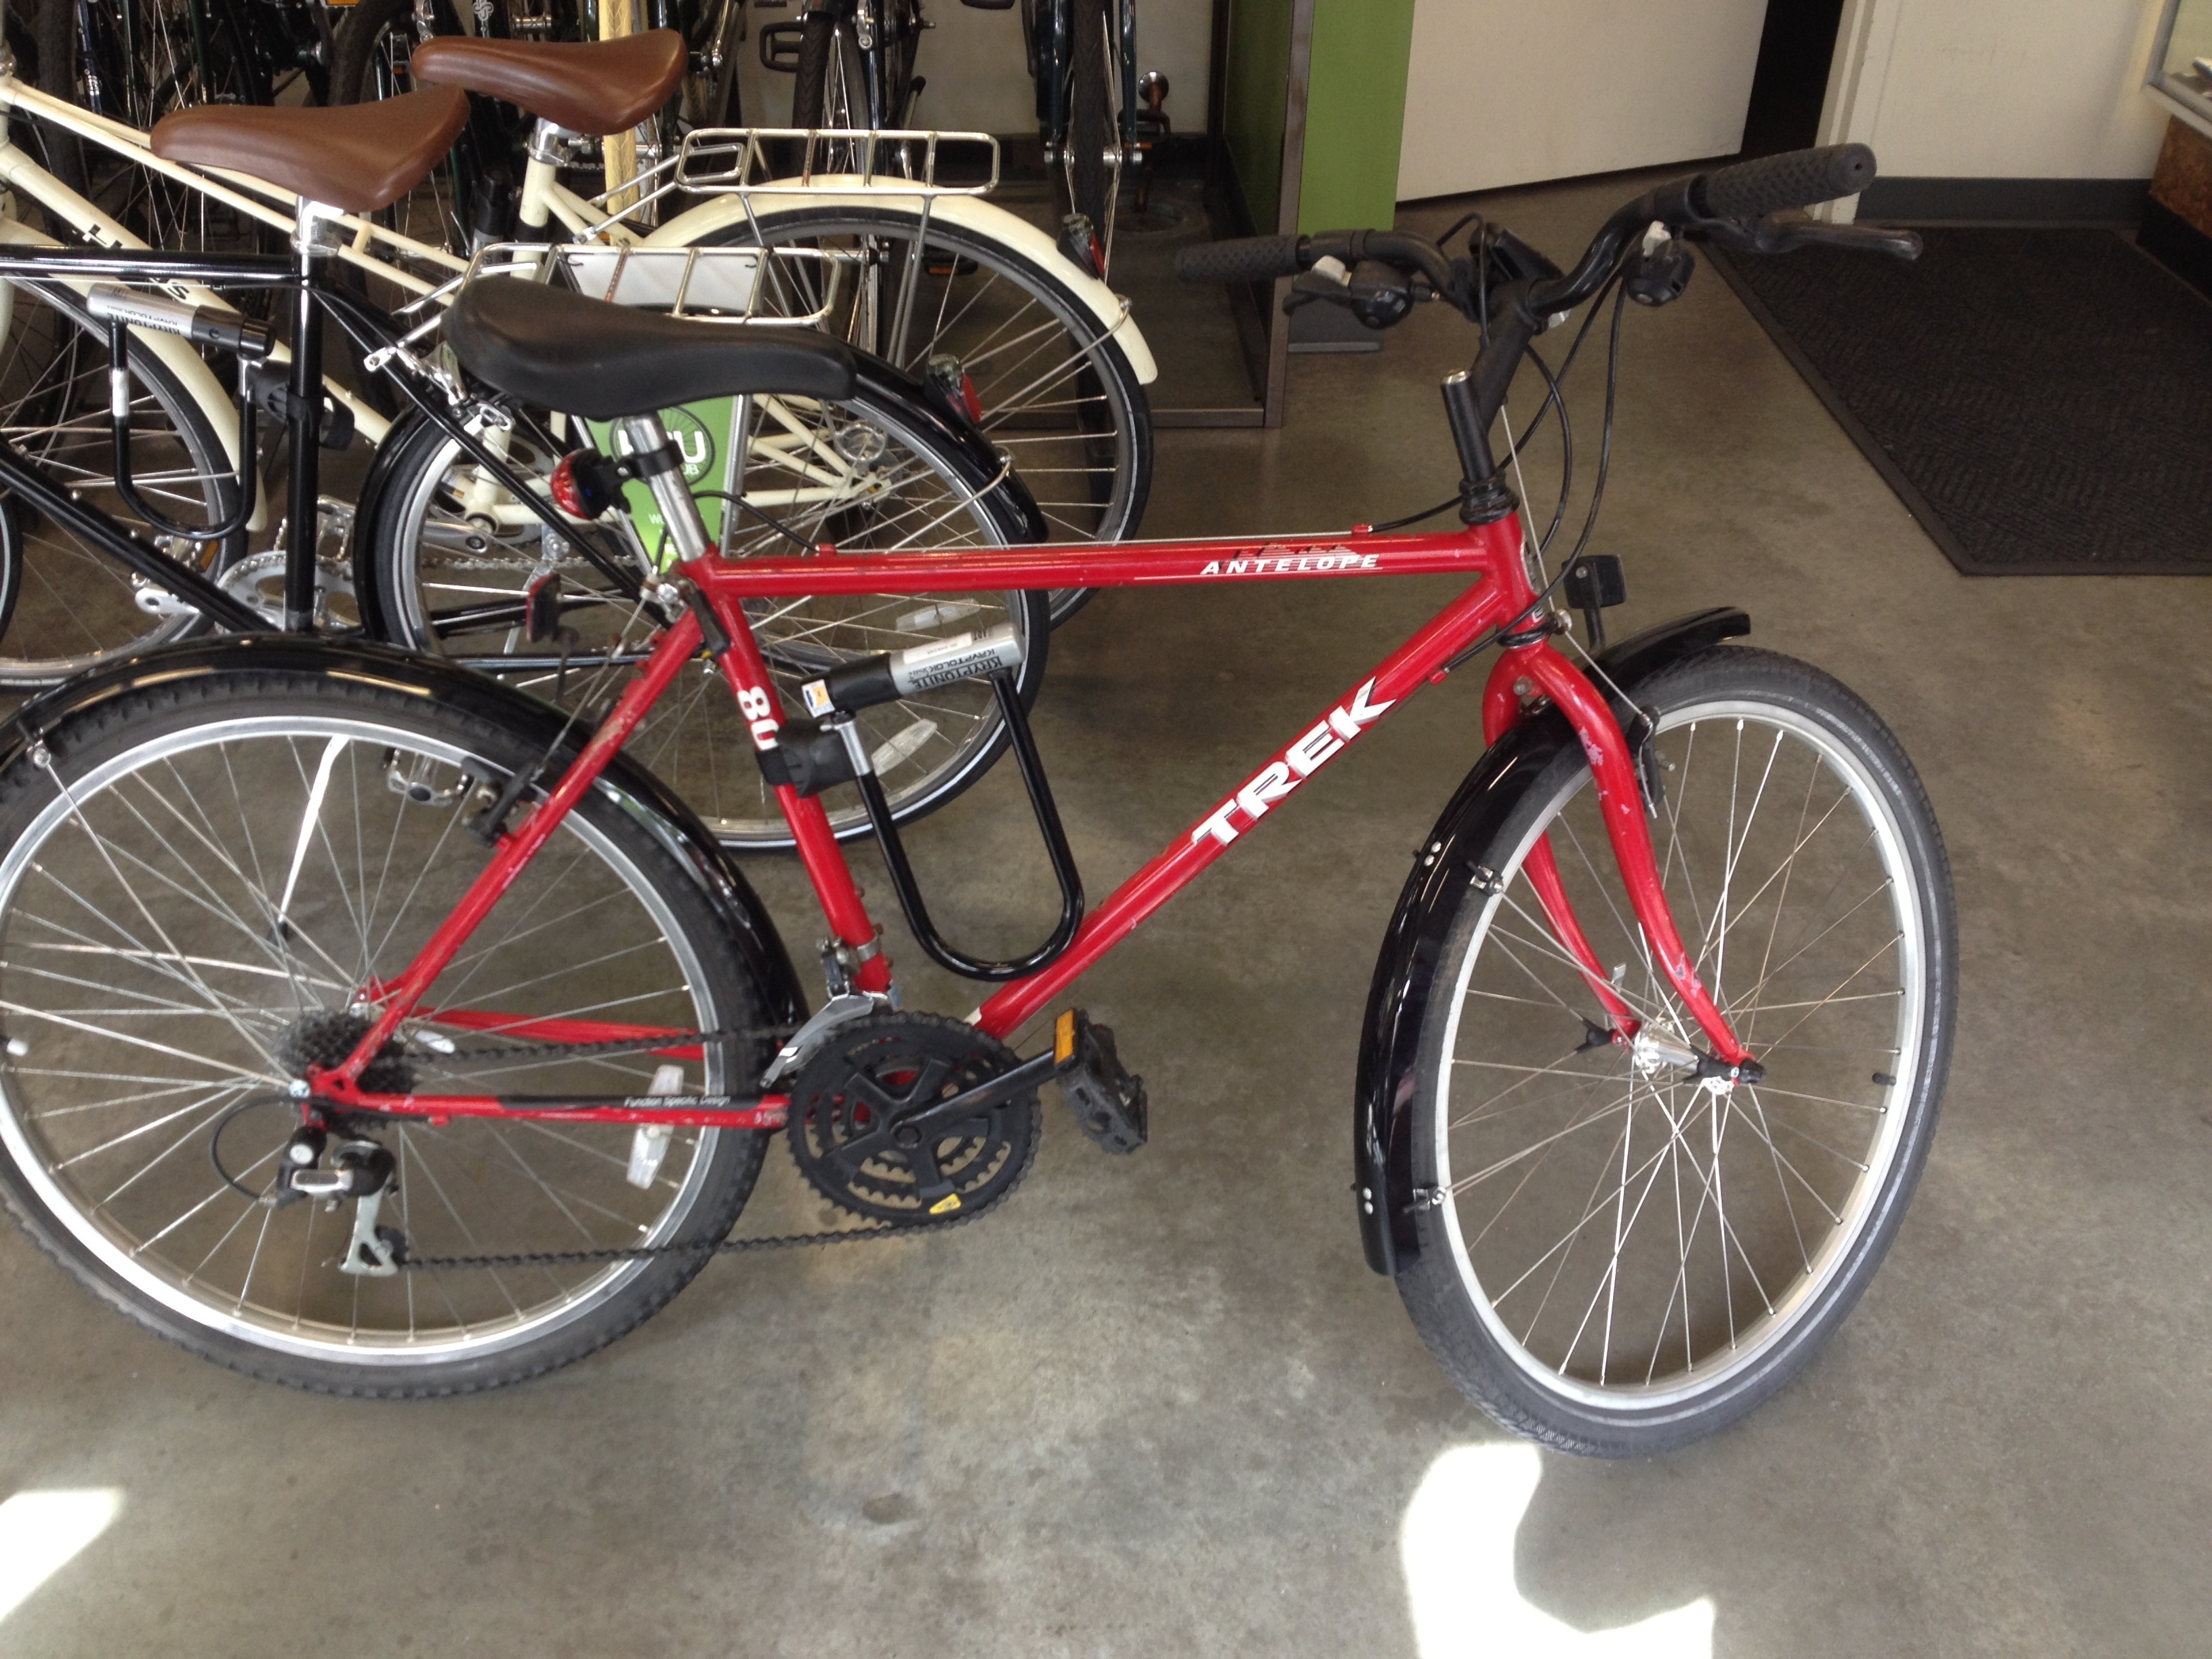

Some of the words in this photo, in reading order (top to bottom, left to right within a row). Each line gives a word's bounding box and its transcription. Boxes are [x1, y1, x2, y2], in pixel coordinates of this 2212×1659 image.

[1200, 554, 1380, 575] ANTELOPE
[914, 655, 1003, 689] KRYPTONITE
[930, 649, 995, 672] KRYPTOLOK
[1191, 676, 1397, 846] TREK
[699, 1096, 731, 1108] Design
